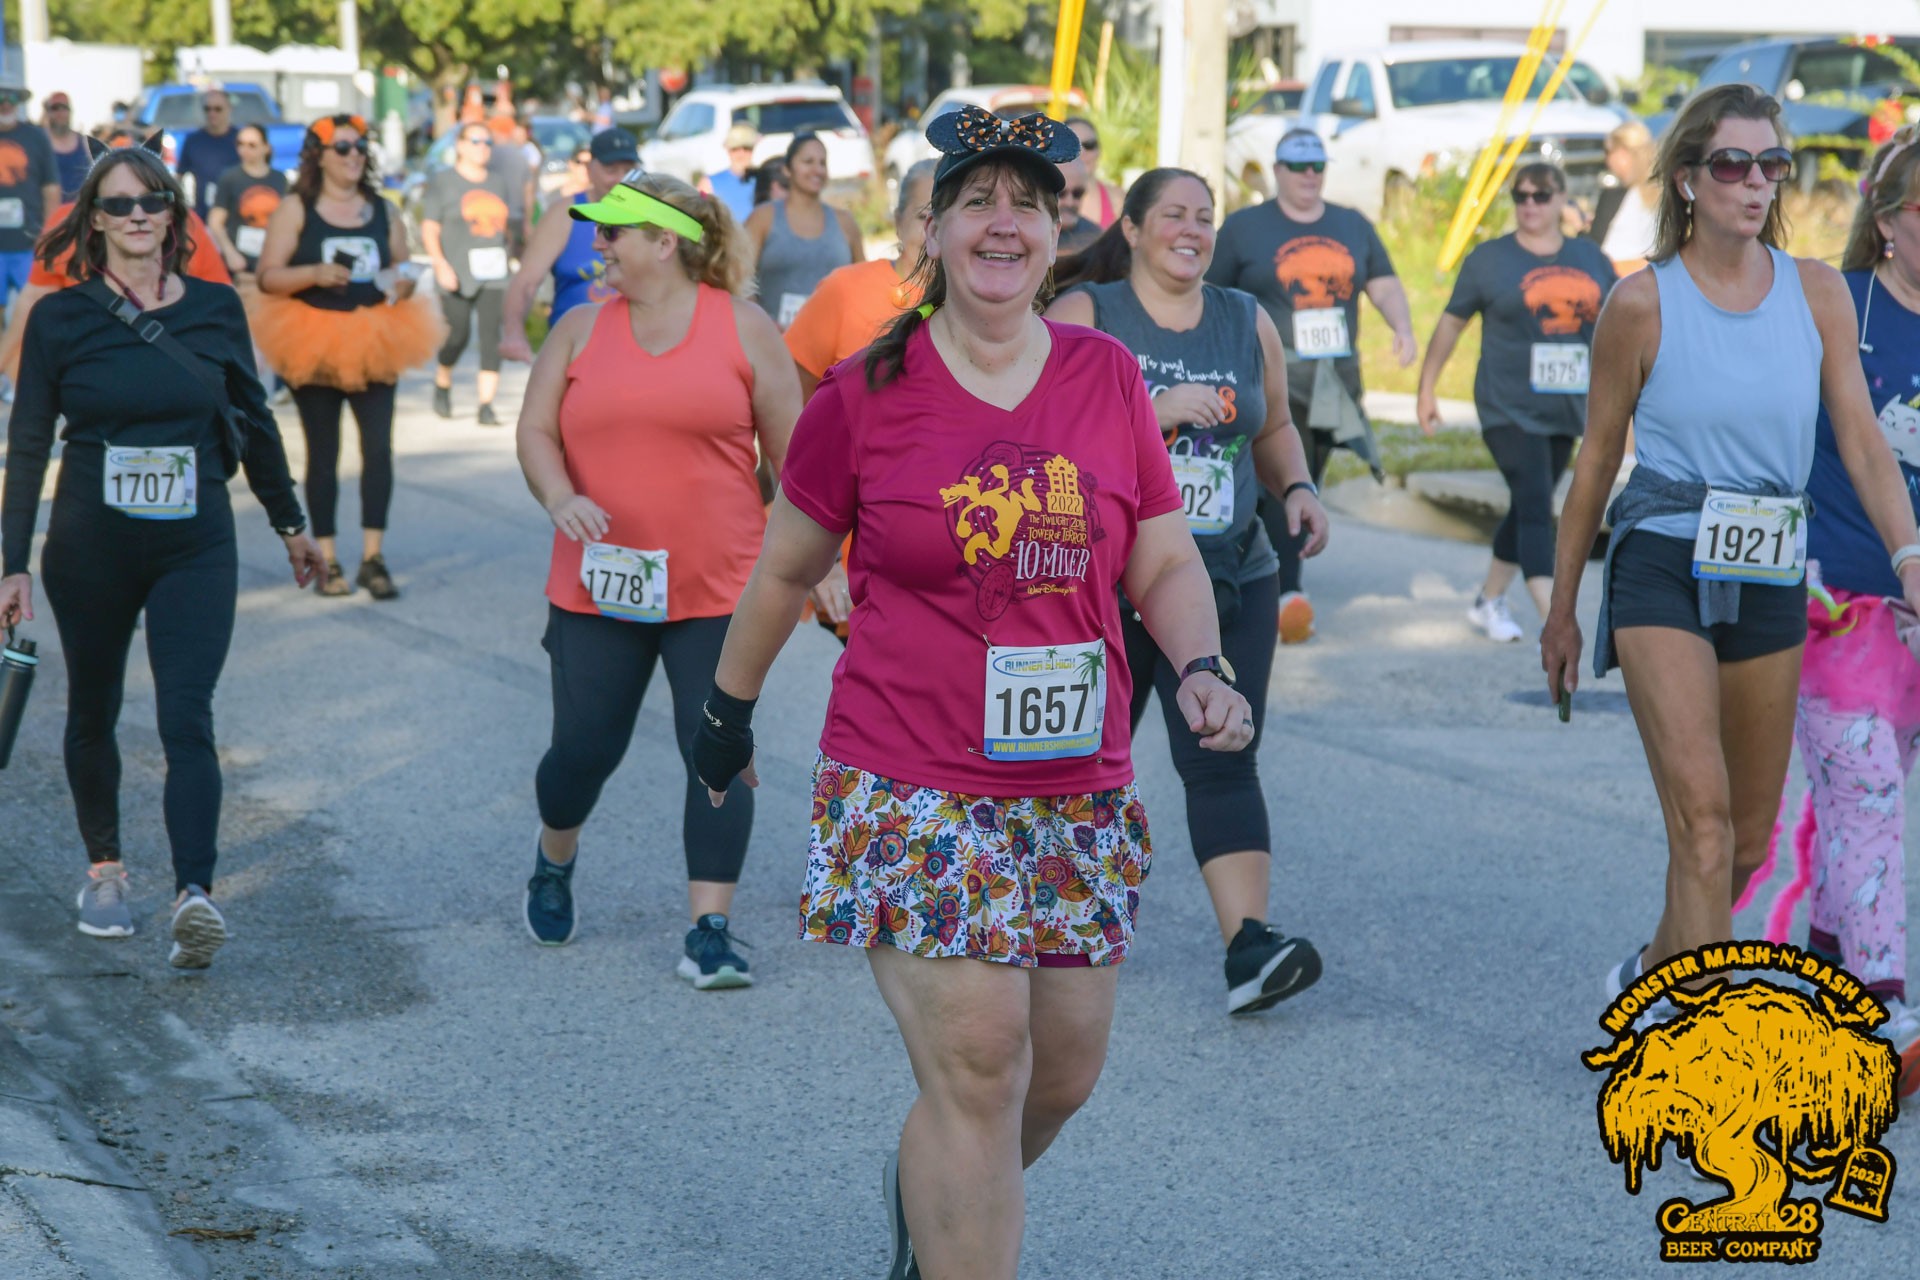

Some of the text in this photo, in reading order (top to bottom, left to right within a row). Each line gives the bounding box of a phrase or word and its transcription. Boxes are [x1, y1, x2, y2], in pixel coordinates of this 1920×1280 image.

[1301, 327, 1340, 347] 1801
[1539, 362, 1578, 383] 1575
[112, 472, 176, 503] 1707
[1050, 494, 1081, 513] 2022
[1177, 483, 1213, 517] 02
[1027, 526, 1055, 542] TOWER
[1061, 527, 1088, 547] TERROR
[1707, 523, 1784, 565] 1921
[1015, 540, 1091, 582] 10 MILER
[586, 568, 644, 605] 1778
[996, 683, 1090, 736] 1657
